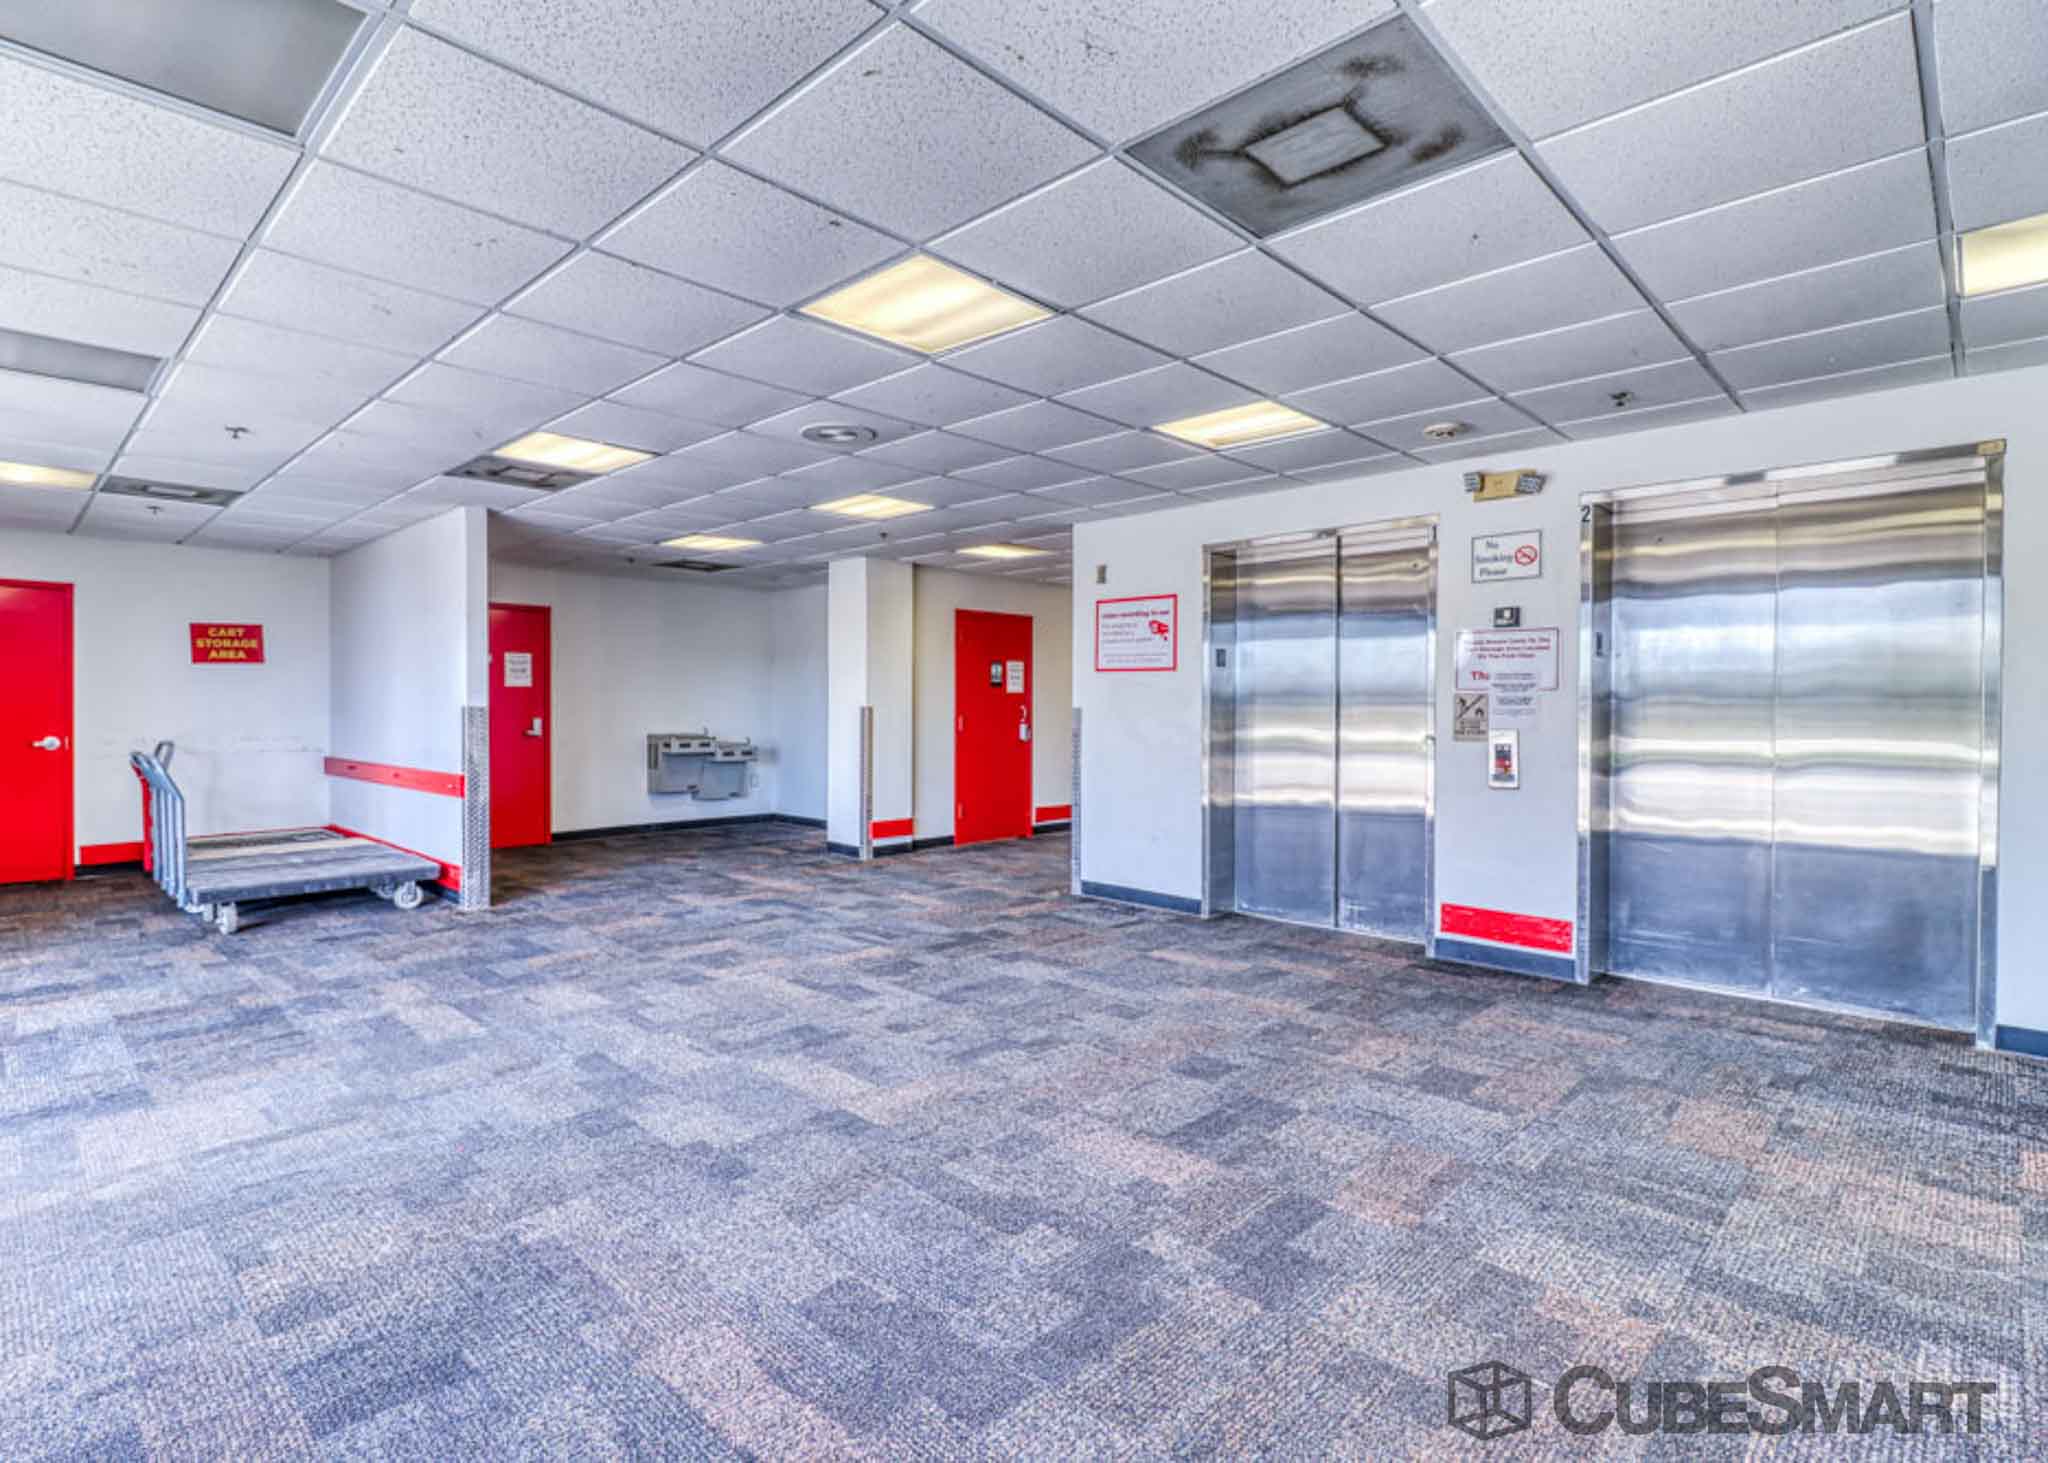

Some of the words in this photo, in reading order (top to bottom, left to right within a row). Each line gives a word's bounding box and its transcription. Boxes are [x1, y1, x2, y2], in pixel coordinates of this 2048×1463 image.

[1580, 504, 1591, 522] 2
[207, 627, 245, 637] CART
[196, 638, 258, 649] STORAGE
[207, 649, 248, 659] AREA
